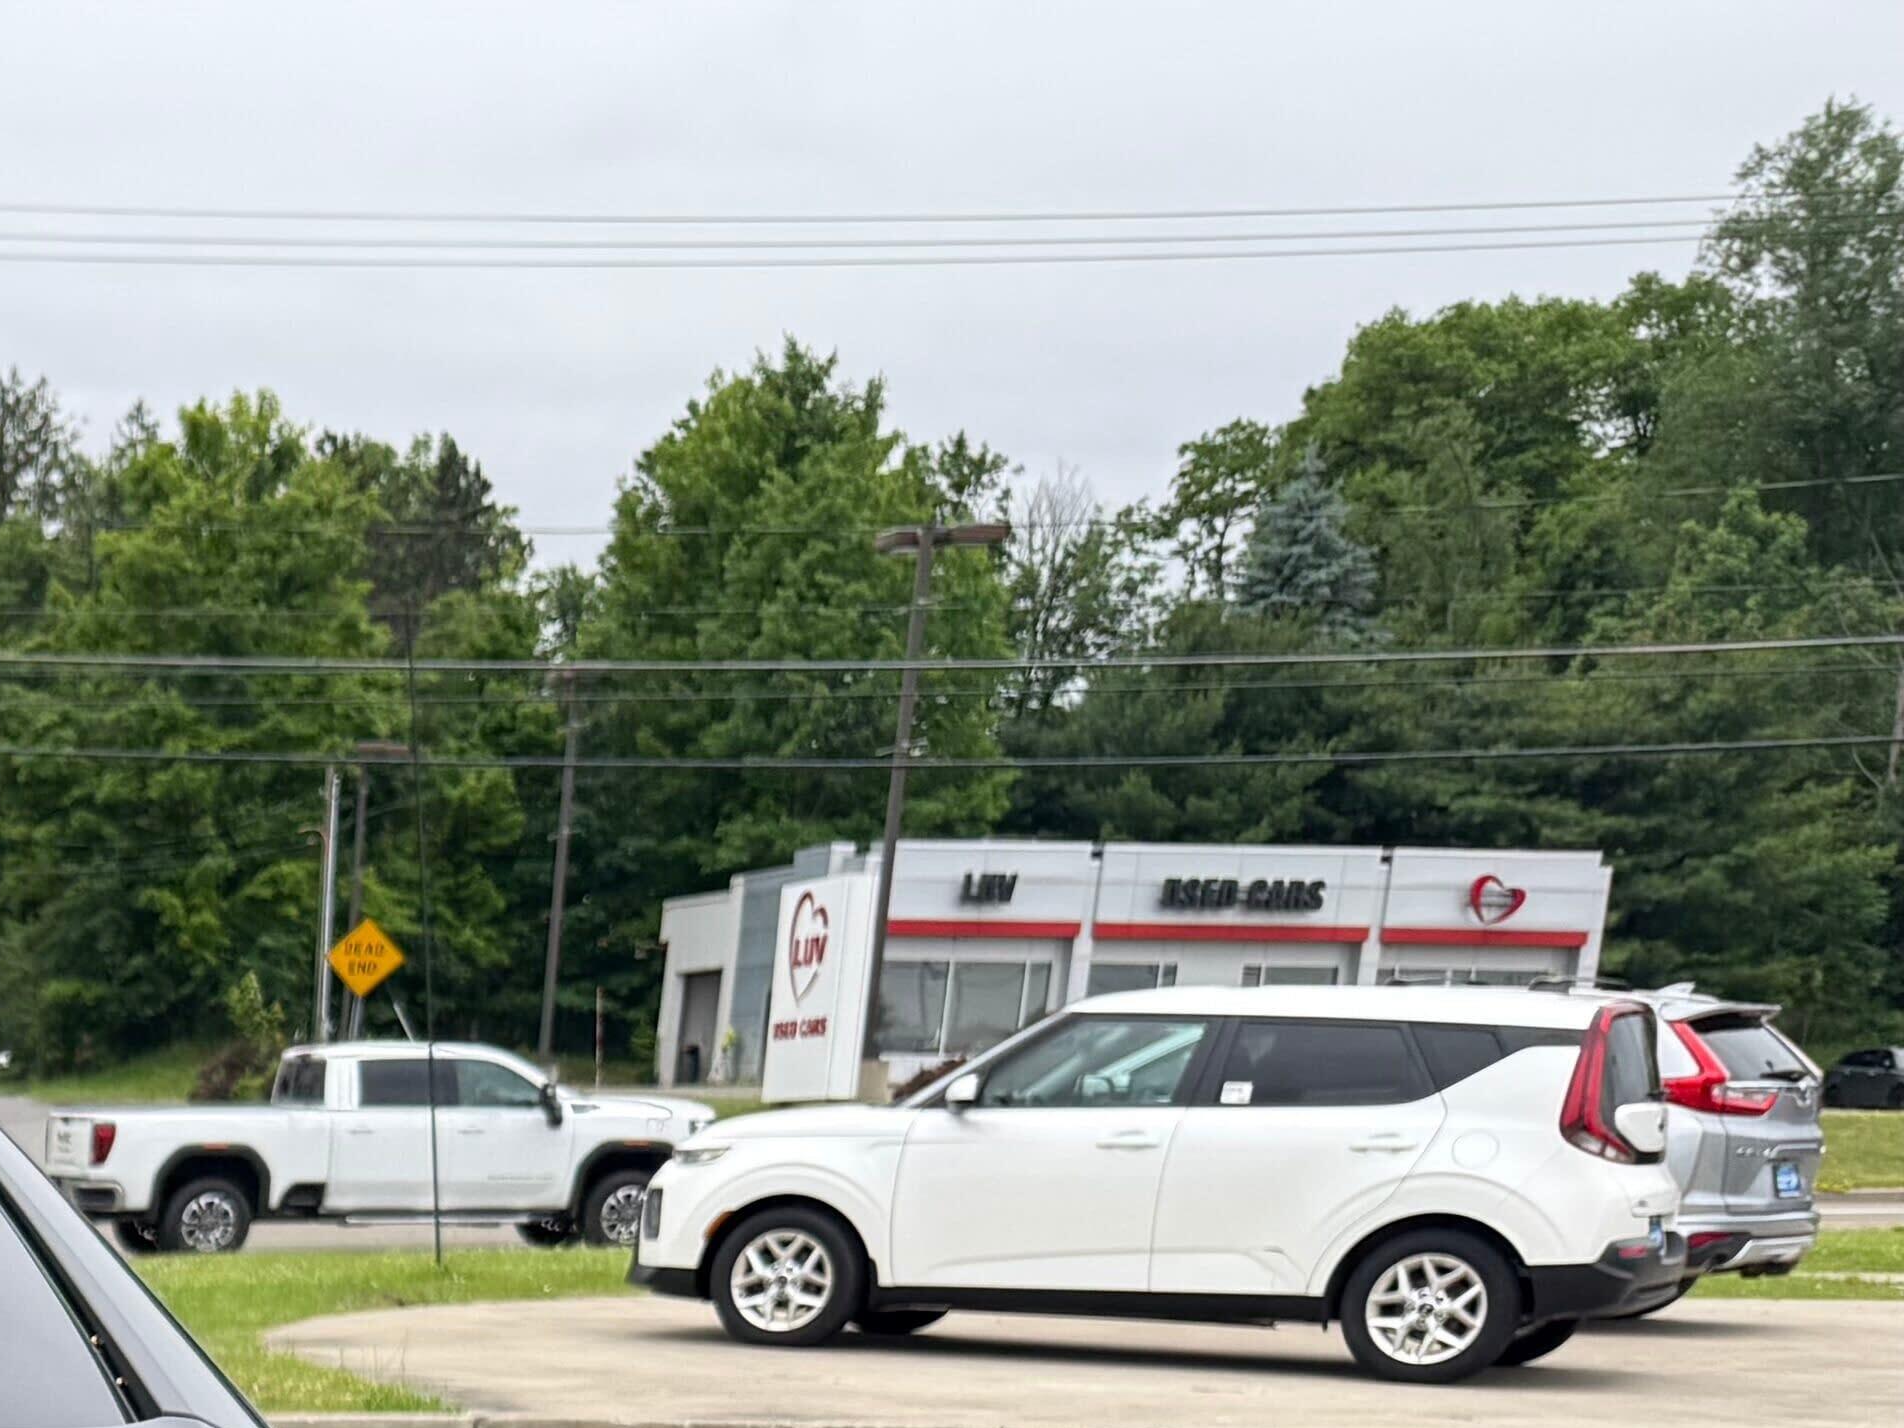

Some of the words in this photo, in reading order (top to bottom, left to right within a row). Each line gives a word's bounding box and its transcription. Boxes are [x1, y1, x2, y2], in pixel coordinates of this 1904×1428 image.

[1161, 878, 1240, 910] USED
[1247, 879, 1326, 911] CARS
[343, 941, 385, 957] DEAD
[792, 934, 828, 969] LUV
[348, 960, 377, 976] END
